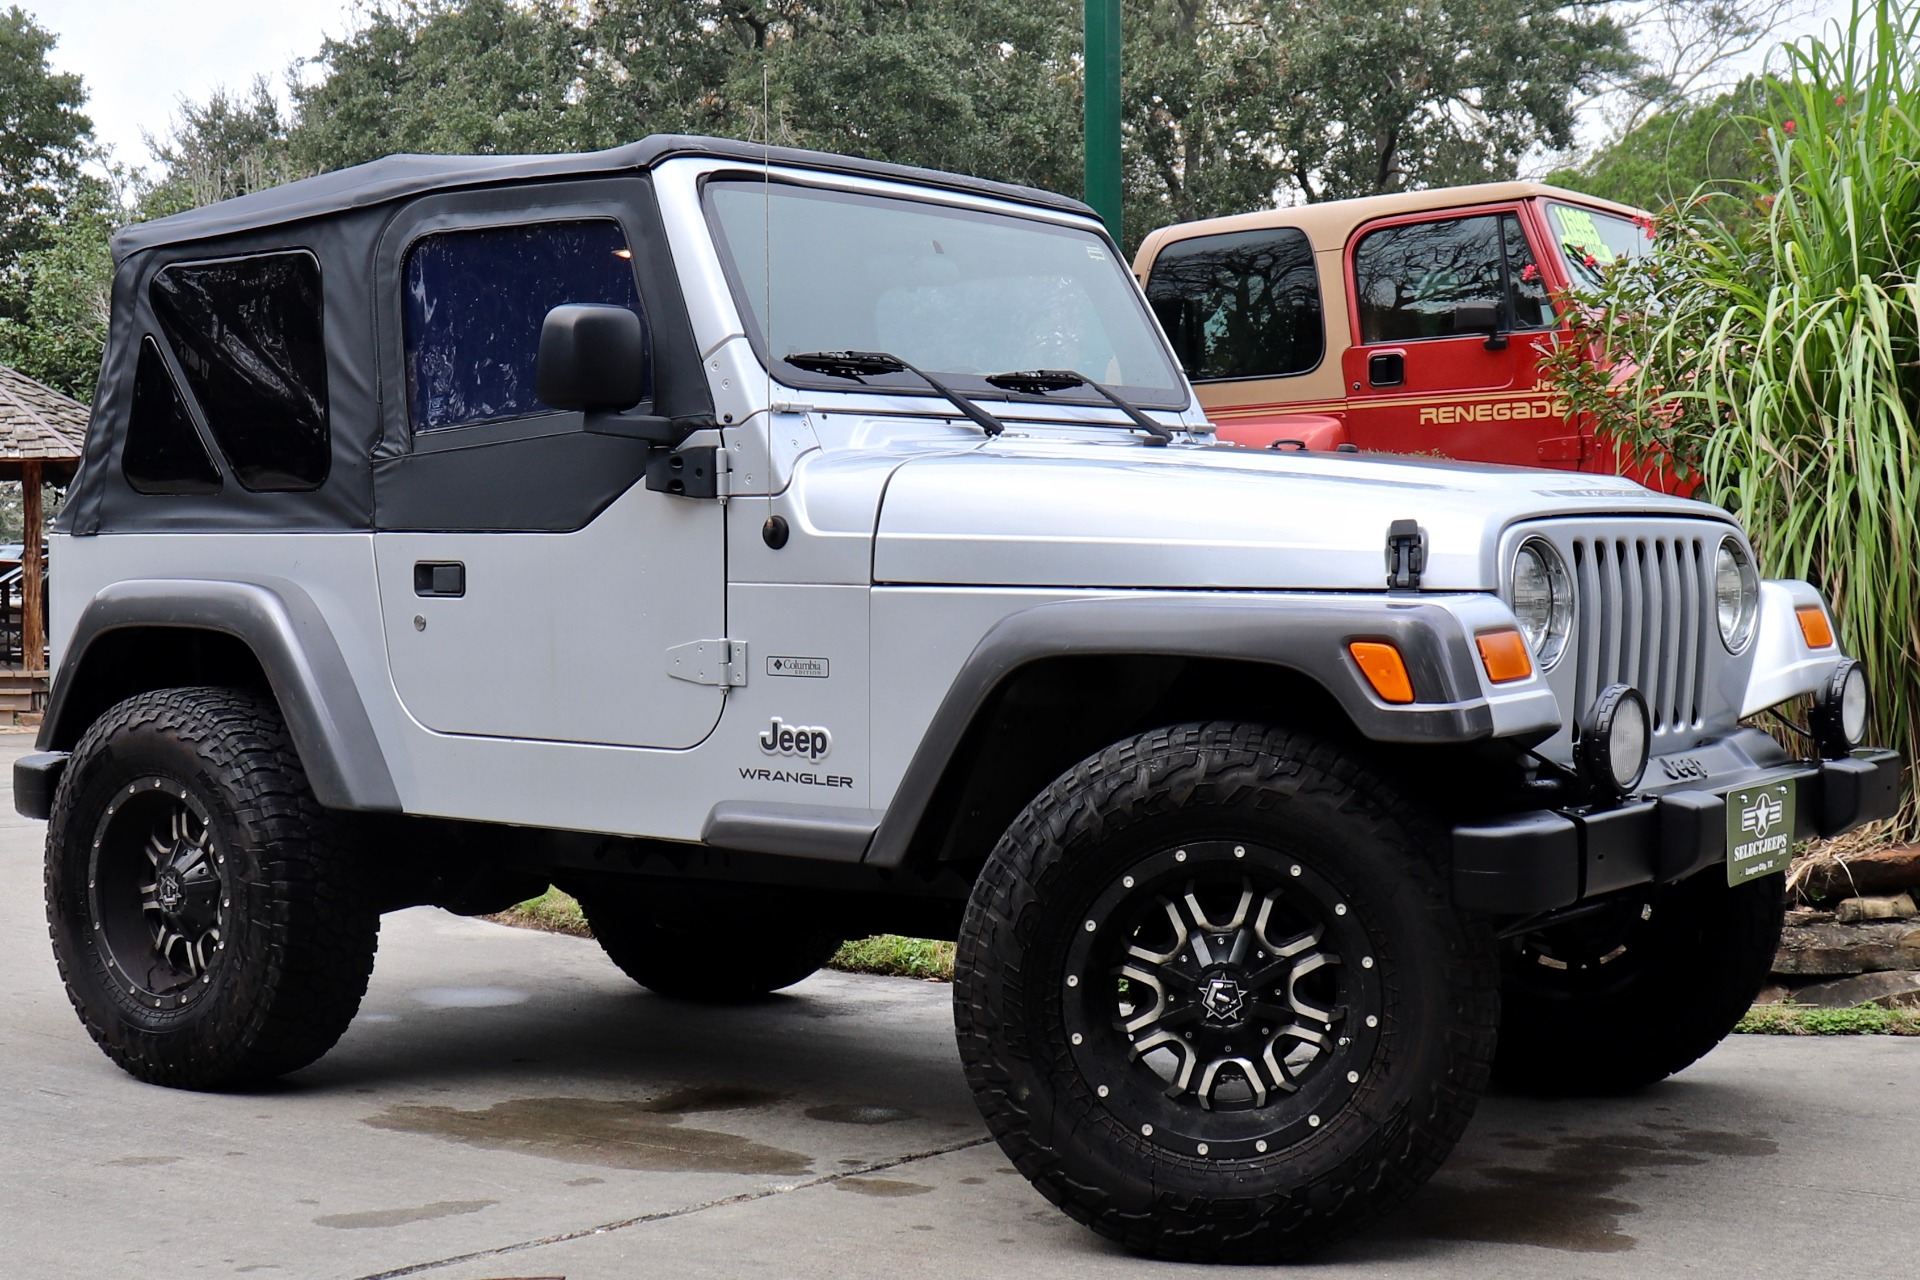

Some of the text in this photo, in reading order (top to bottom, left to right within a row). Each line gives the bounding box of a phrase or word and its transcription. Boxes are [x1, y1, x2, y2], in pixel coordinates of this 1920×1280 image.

[1420, 400, 1569, 425] RENEGADE
[783, 659, 821, 671] Columbia
[760, 718, 830, 763] Jeep
[739, 768, 853, 788] WRANGLER
[1659, 757, 1708, 780] Jeep
[1734, 833, 1788, 861] SELECTJEEPS
